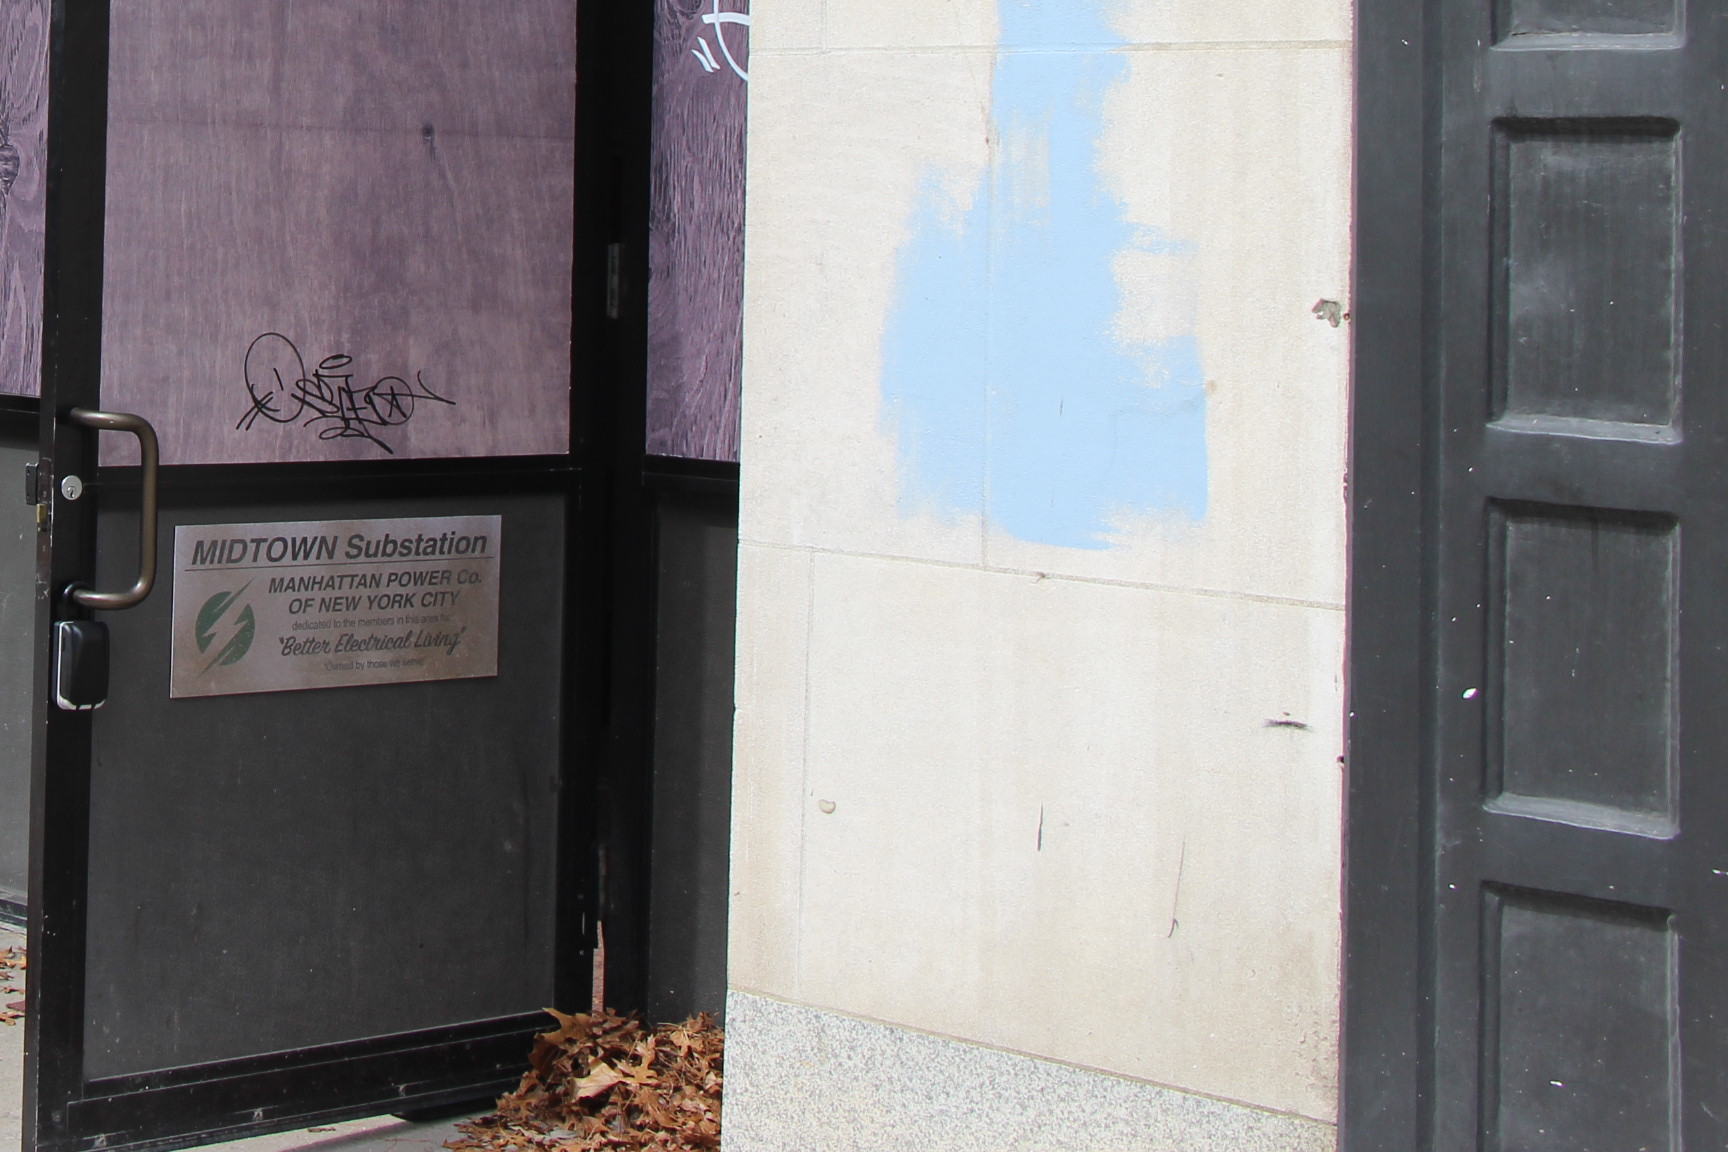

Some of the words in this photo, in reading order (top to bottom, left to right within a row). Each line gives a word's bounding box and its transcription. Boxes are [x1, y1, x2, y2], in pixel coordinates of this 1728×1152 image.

[192, 536, 338, 565] MIDTOWN
[345, 531, 488, 560] Substation
[268, 573, 383, 594] MANHATTAN
[386, 570, 451, 589] POWER
[457, 569, 481, 584] Co.
[289, 597, 315, 614] OF
[318, 596, 363, 613] NEW
[366, 593, 415, 610] YORK
[420, 590, 460, 607] CITY
[292, 619, 331, 631] dedicated
[333, 619, 341, 628] to
[343, 618, 356, 628] the
[357, 616, 394, 627] members
[396, 615, 403, 624] in
[405, 614, 419, 624] this
[420, 614, 438, 623] area
[279, 636, 331, 656] "Better
[334, 630, 411, 653] Electrical
[356, 660, 364, 670] by
[367, 659, 387, 669] those
